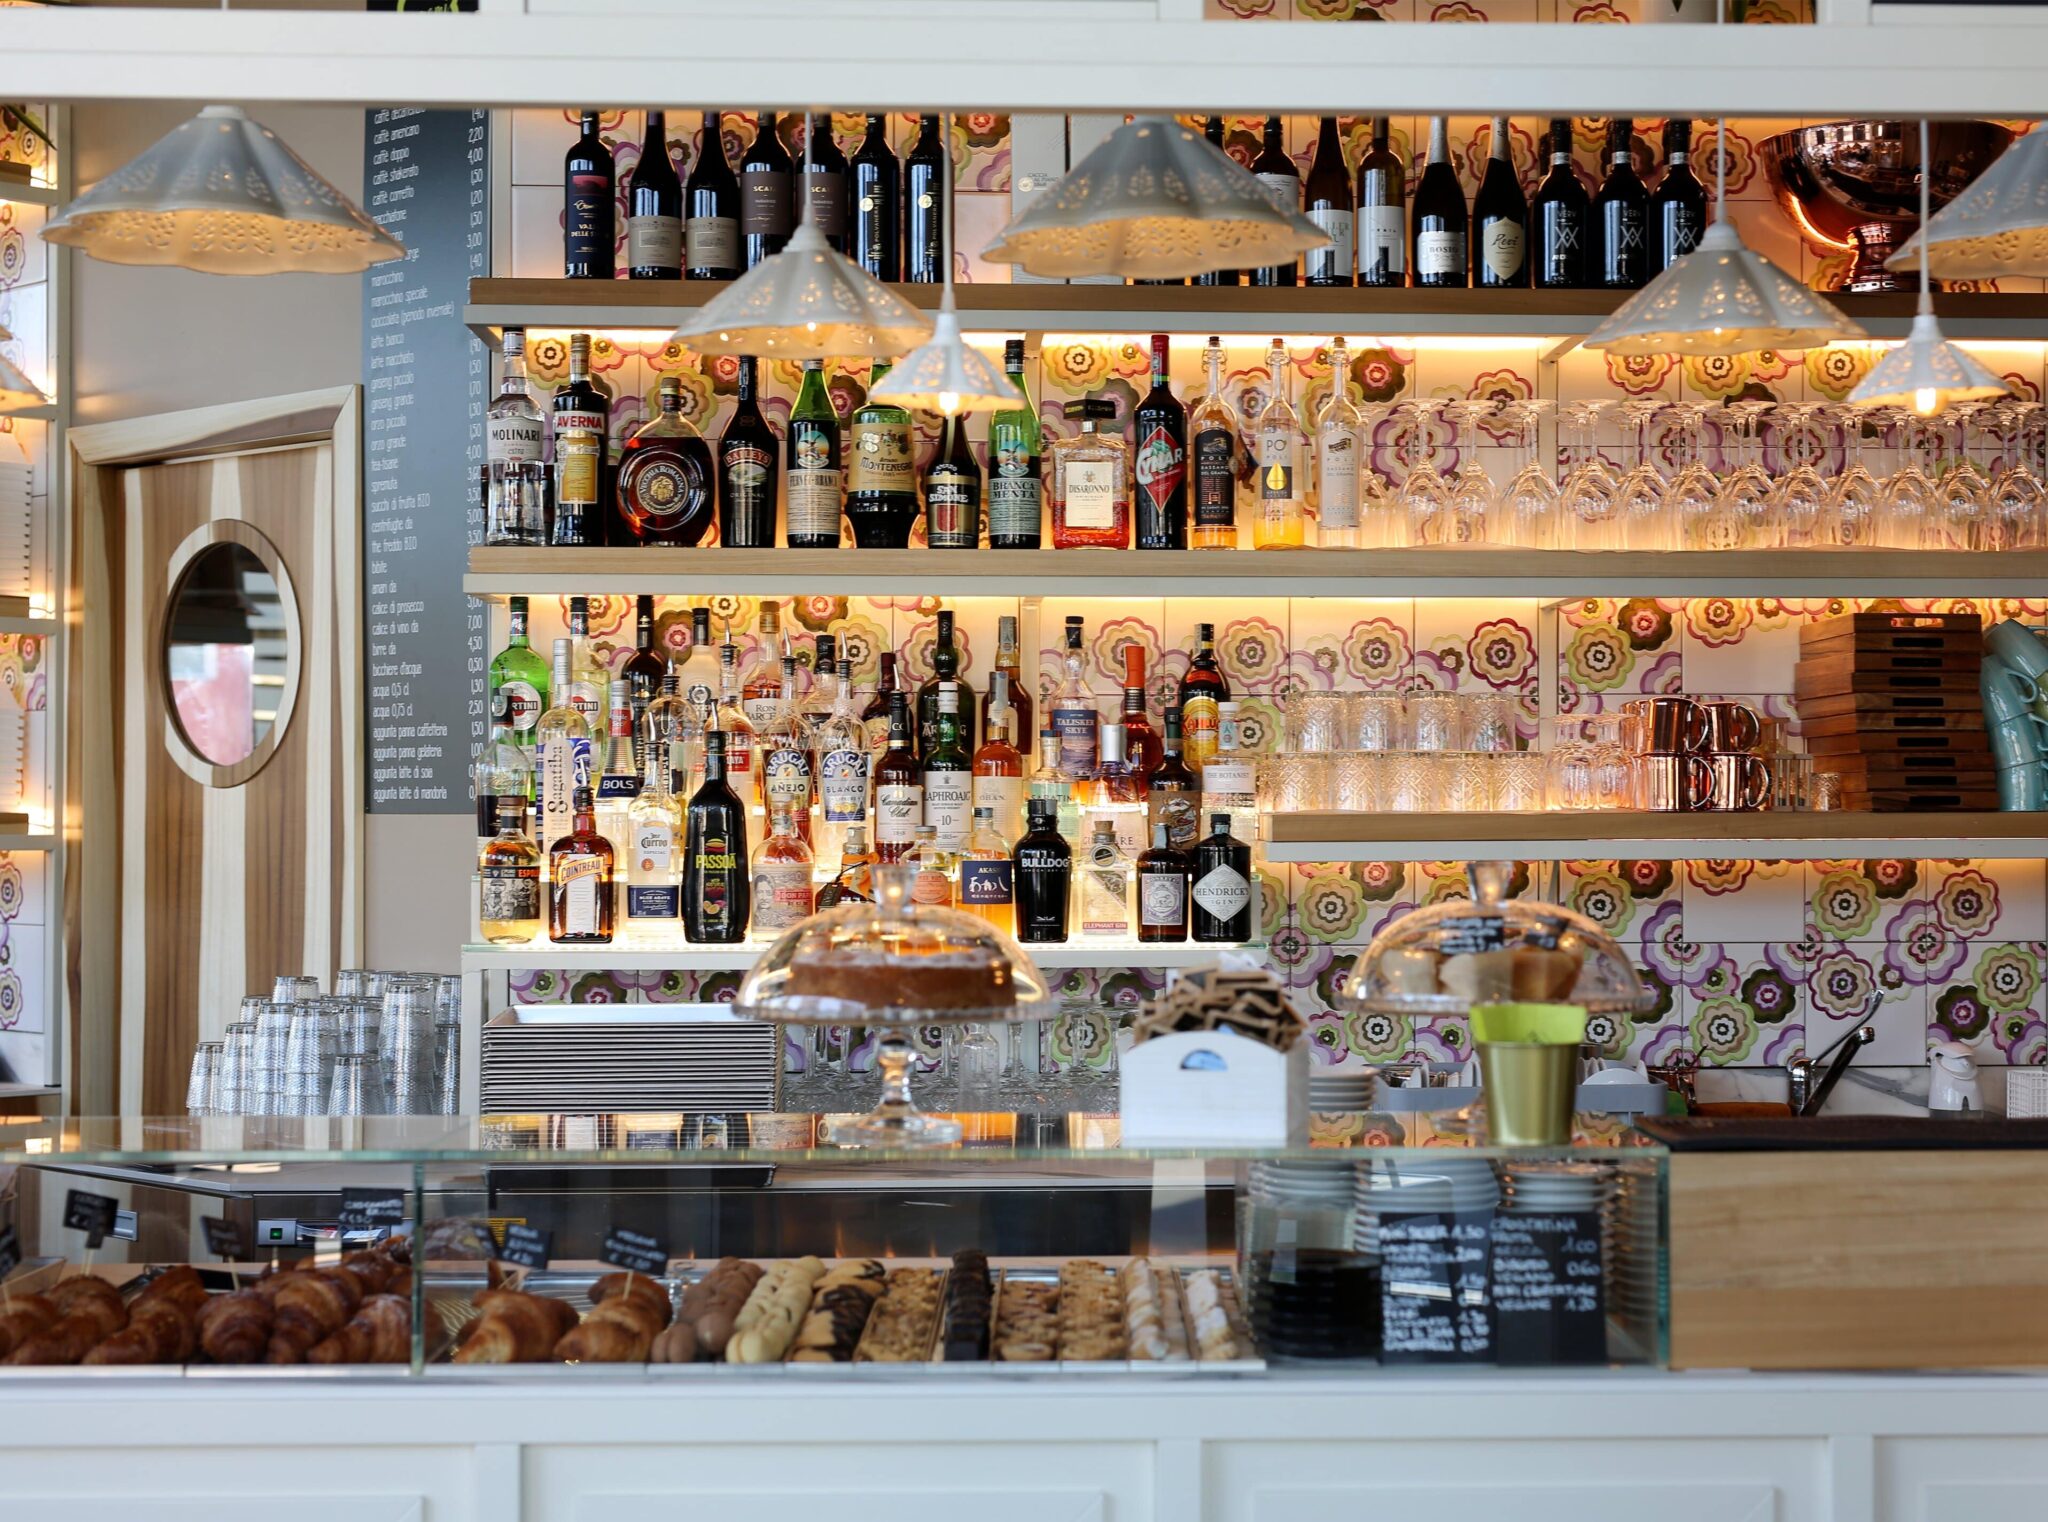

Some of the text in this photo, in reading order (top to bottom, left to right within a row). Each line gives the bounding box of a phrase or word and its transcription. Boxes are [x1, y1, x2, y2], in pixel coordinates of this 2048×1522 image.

[557, 416, 602, 429] AVERNA
[492, 429, 540, 441] MOLINARI
[726, 449, 769, 463] BALEYS
[937, 485, 958, 494] SAN
[993, 481, 1035, 490] BRANCA
[1069, 484, 1110, 494] DISARONNO
[929, 494, 969, 502] SIMONE
[993, 490, 1035, 499] MENTA
[511, 701, 538, 710] RTINI
[572, 701, 598, 711] RTINI
[1056, 718, 1095, 726] TALISKER
[1181, 713, 1219, 735] KAHLÚ
[766, 751, 811, 776] BRUGAL
[823, 753, 866, 778] BRUGAL
[547, 746, 568, 813] Sagatiba
[602, 780, 634, 789] BOLS
[771, 782, 806, 792] AÑEJO
[827, 785, 864, 793] BLANCO
[941, 815, 952, 825] 10
[1021, 858, 1069, 867] BULLDOG
[561, 859, 600, 881] COINTREAU
[1196, 888, 1249, 897] HENDRICK'S
